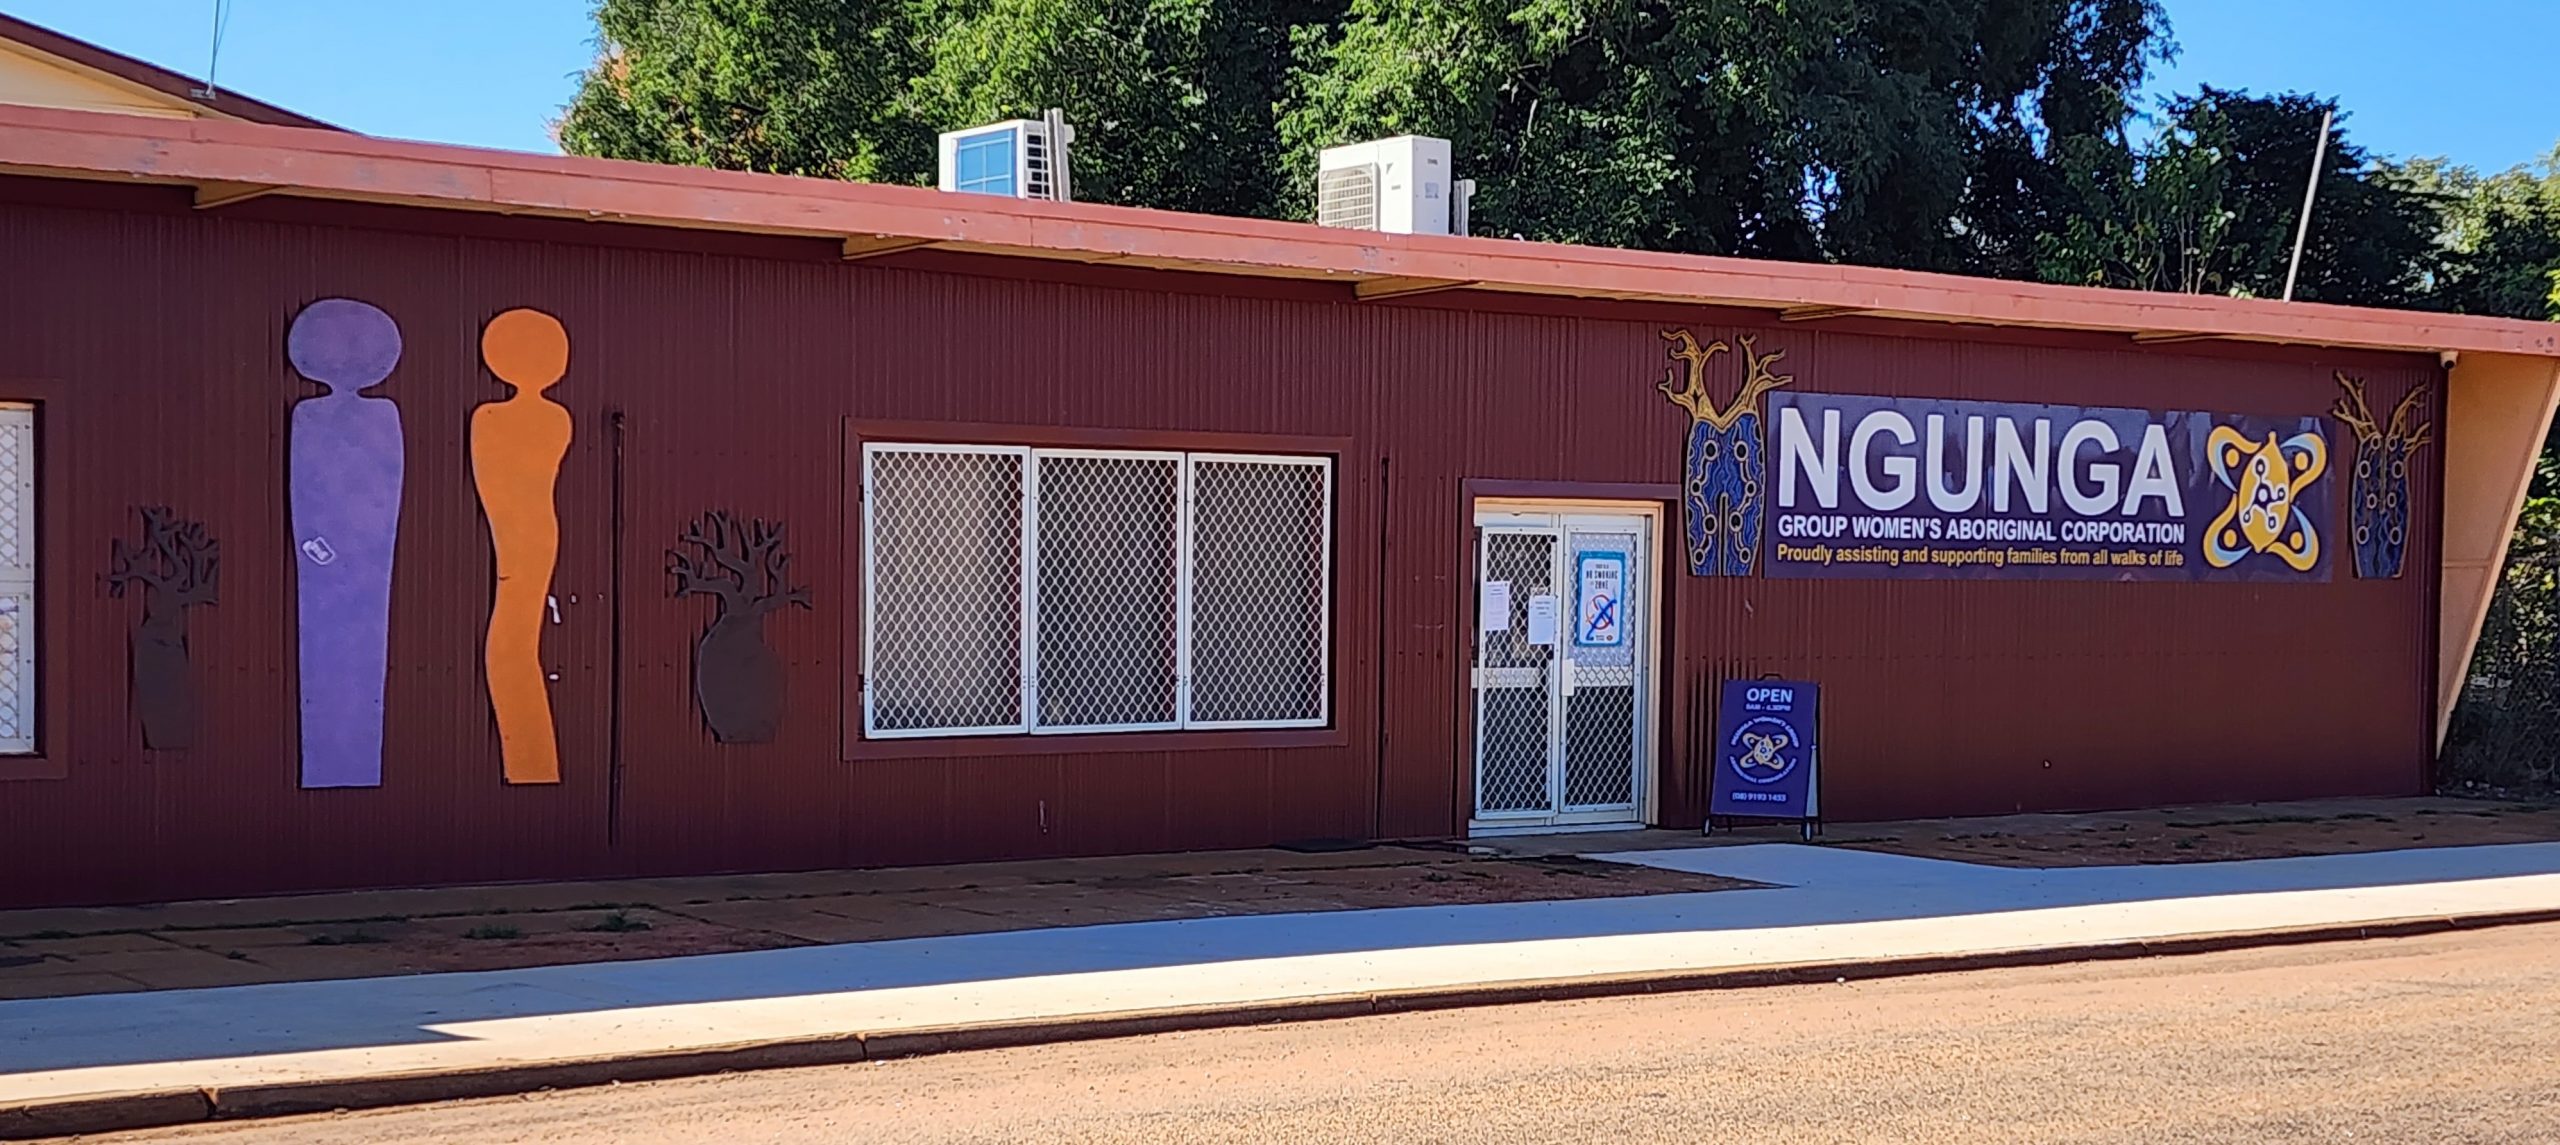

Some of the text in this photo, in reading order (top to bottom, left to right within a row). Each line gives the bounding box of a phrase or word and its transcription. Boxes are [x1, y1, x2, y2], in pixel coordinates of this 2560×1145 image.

[1778, 407, 2185, 517] NGUNGA
[1778, 515, 2185, 544] GROUP WOMEN'S ABORIGINAL CORPORATION
[1777, 543, 2184, 567] Proudly assisting and supporting families from all walks of life
[1746, 687, 1793, 703] OPEN
